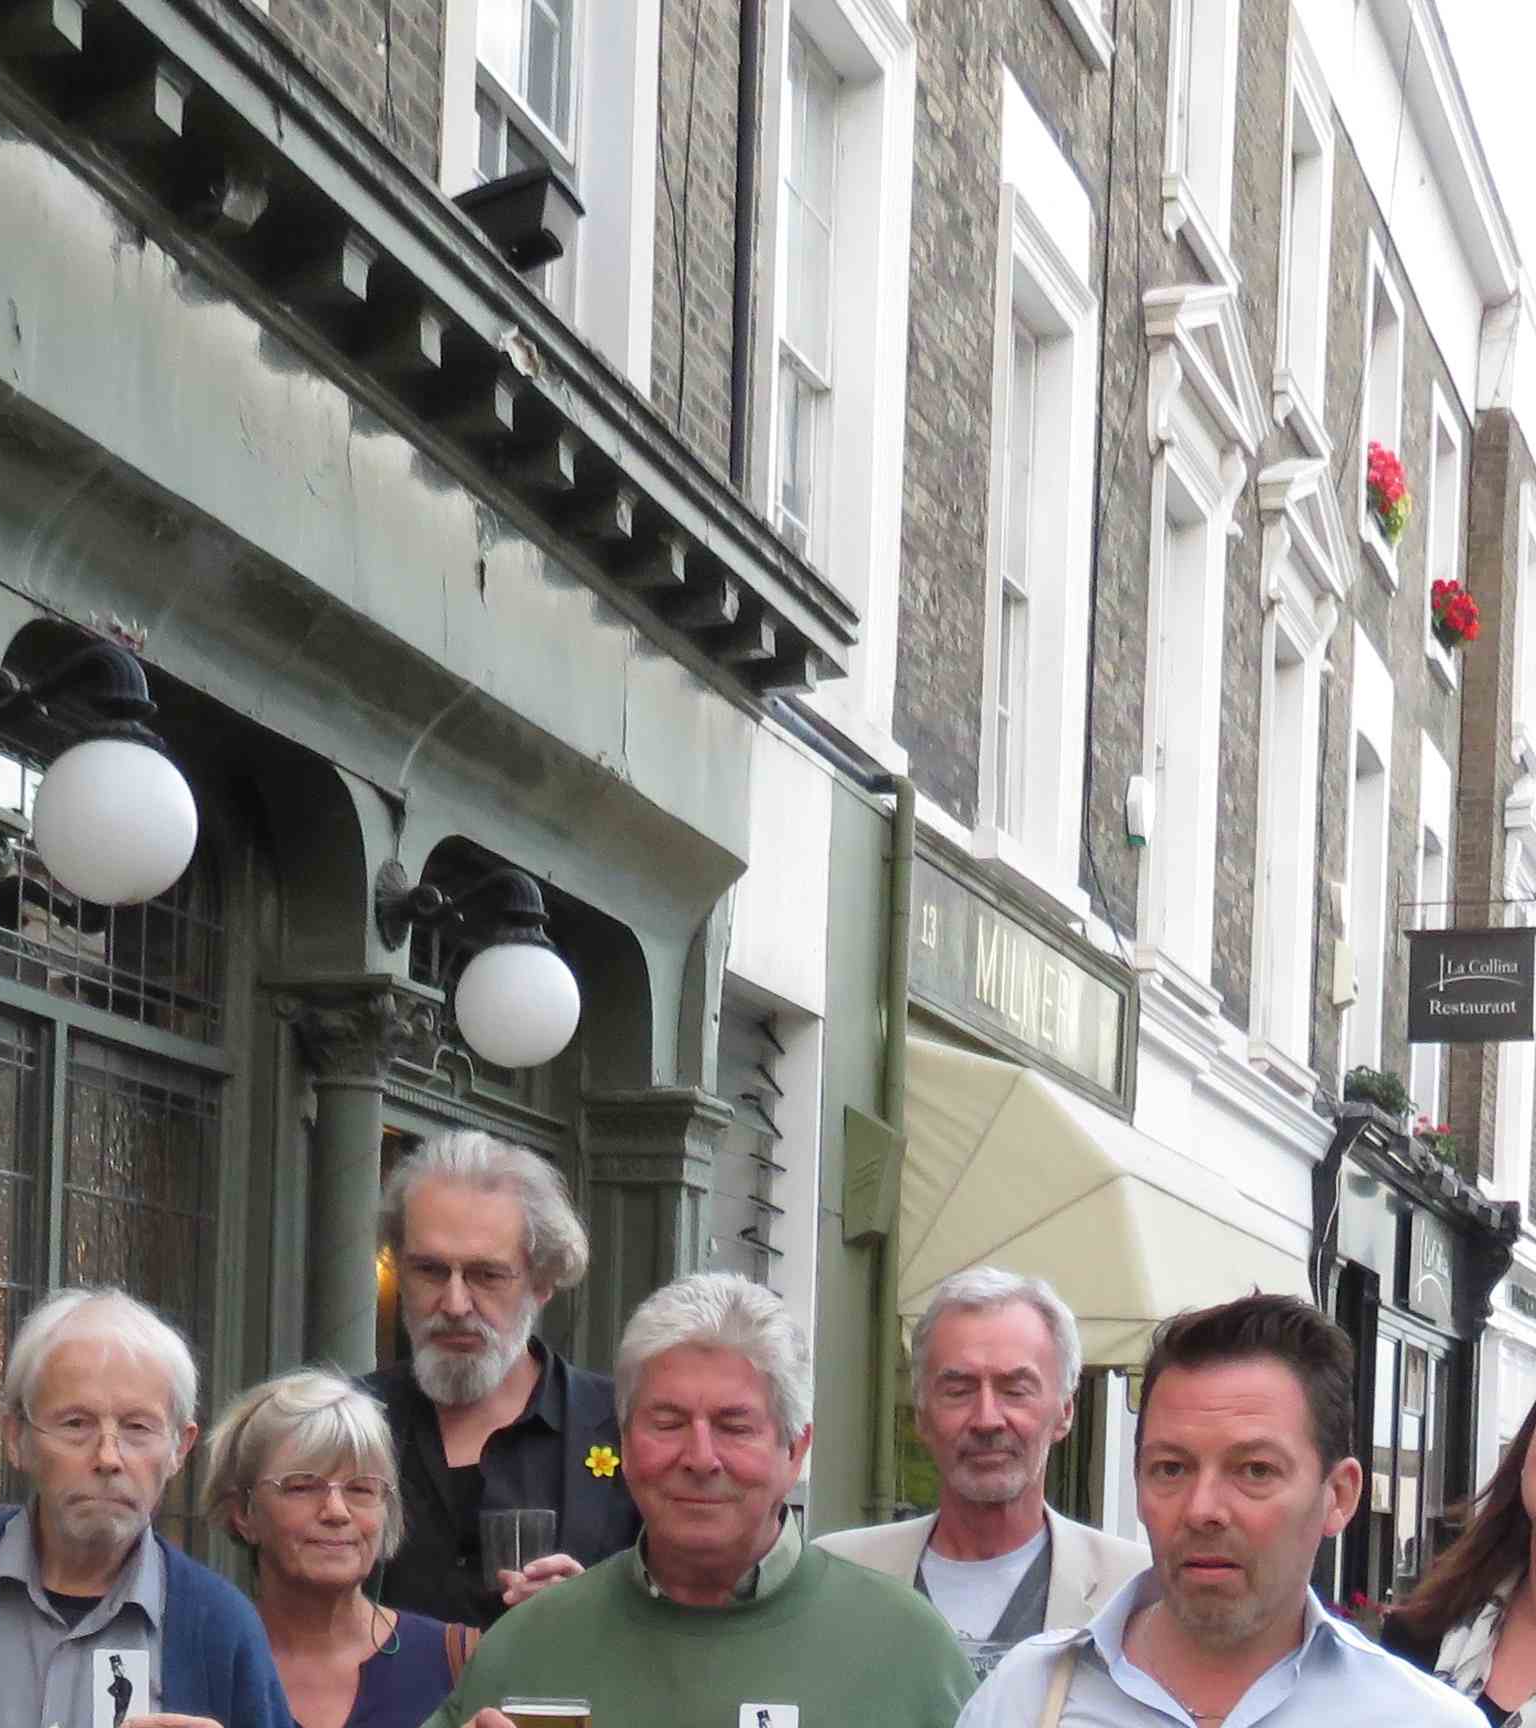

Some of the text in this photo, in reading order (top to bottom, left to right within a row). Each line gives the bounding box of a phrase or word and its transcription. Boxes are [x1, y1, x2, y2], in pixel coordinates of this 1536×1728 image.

[920, 901, 937, 950] 13
[1447, 958, 1519, 975] La Collina
[1429, 999, 1517, 1015] Restaurant
